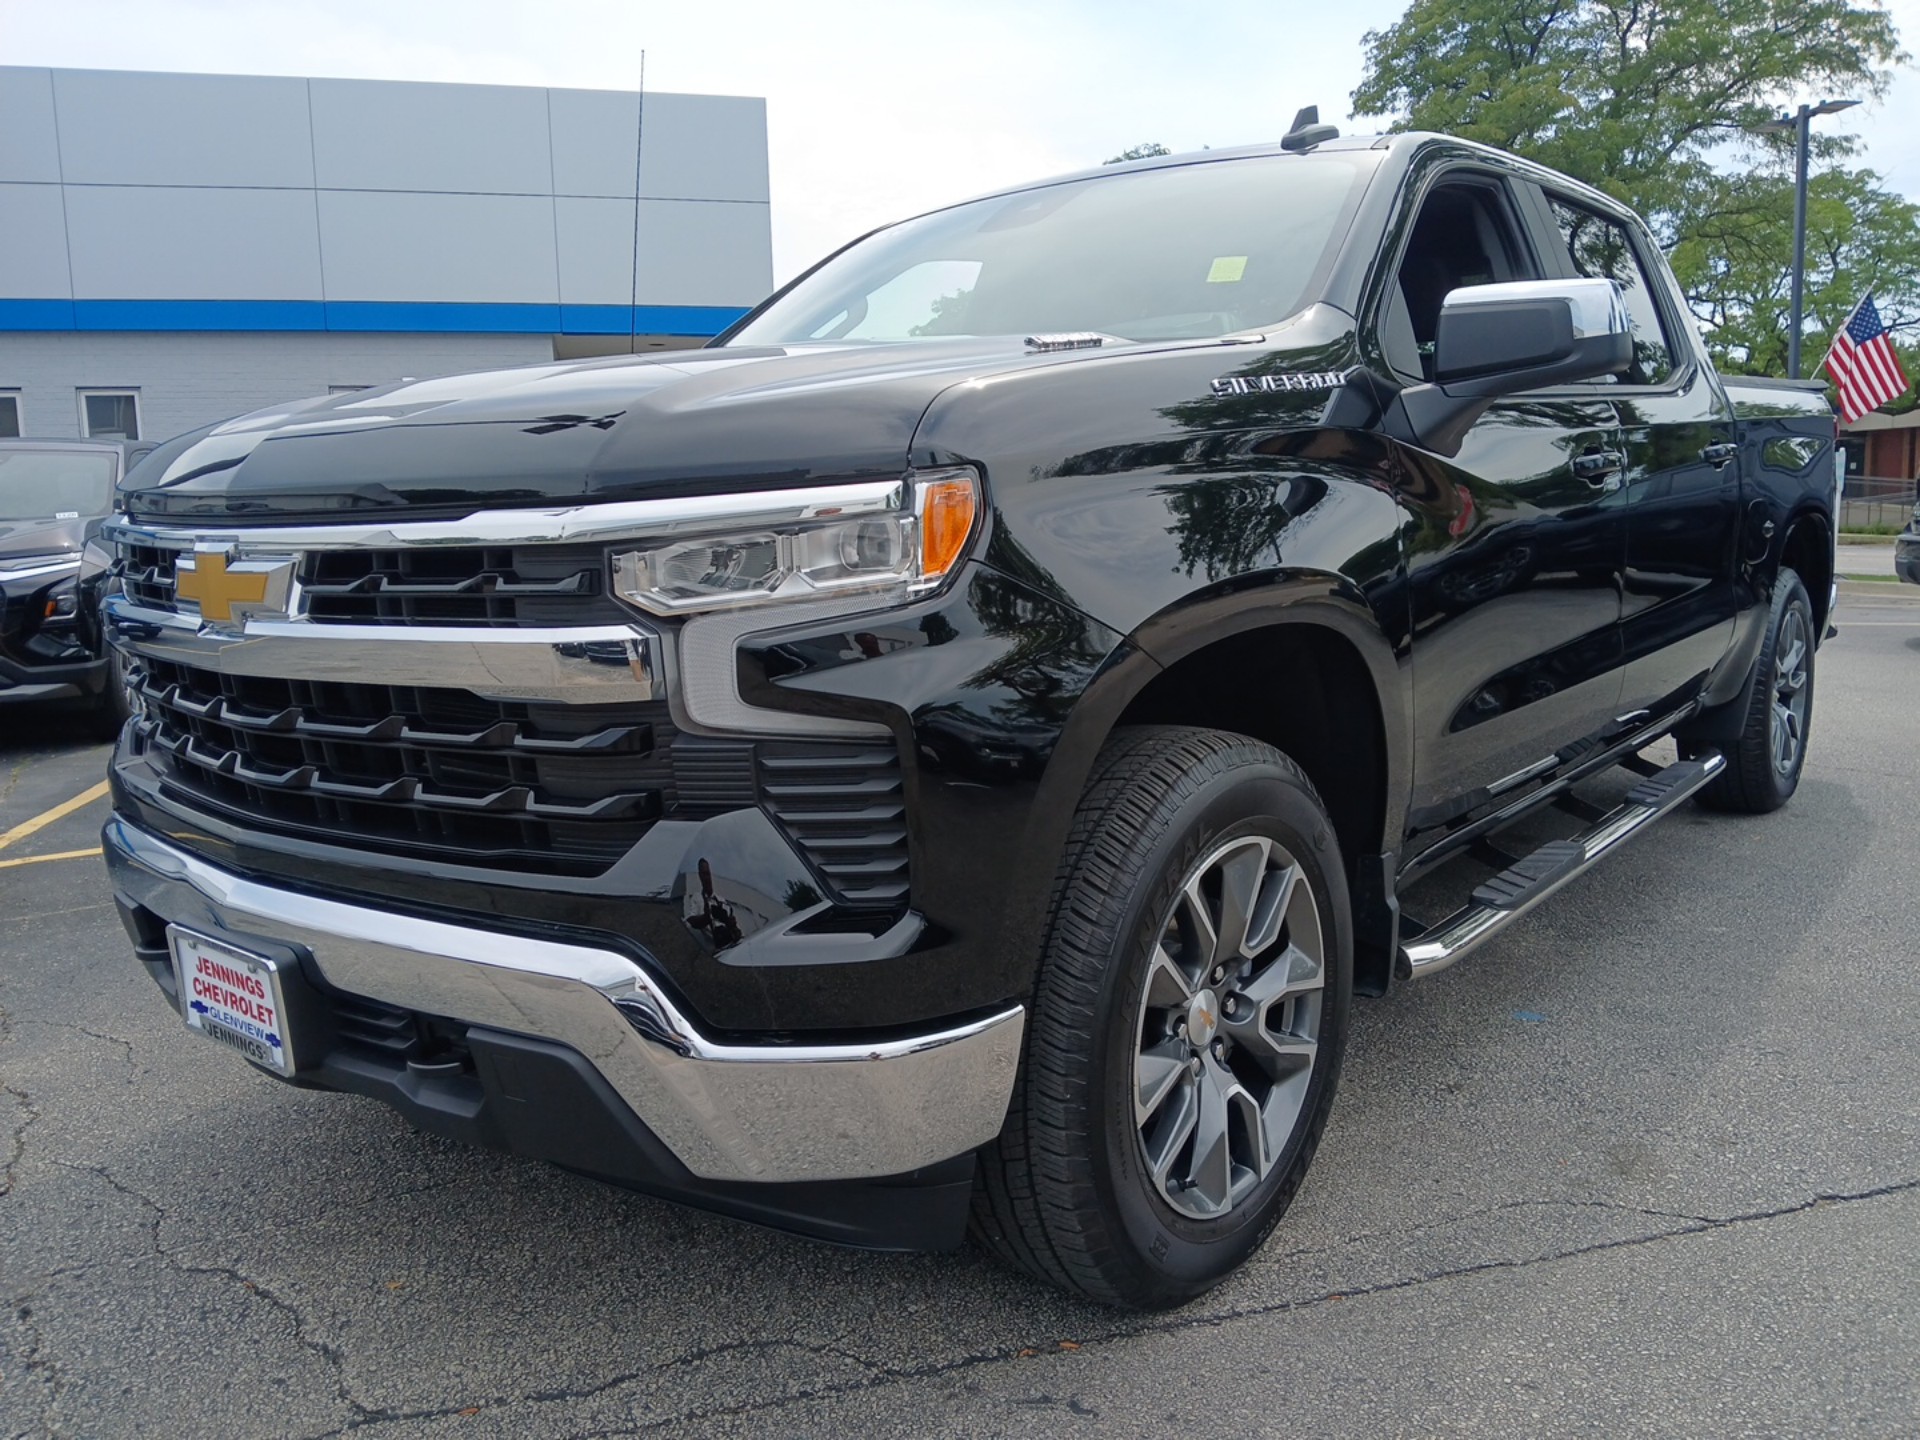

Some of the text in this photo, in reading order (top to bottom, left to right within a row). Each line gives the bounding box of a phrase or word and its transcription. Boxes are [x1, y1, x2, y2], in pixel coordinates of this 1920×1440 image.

[196, 956, 265, 999] JENNINGS
[193, 977, 274, 1027] CHEVROLET
[206, 1023, 264, 1060] JENNINGS
[210, 1007, 265, 1040] GLENVIEW
